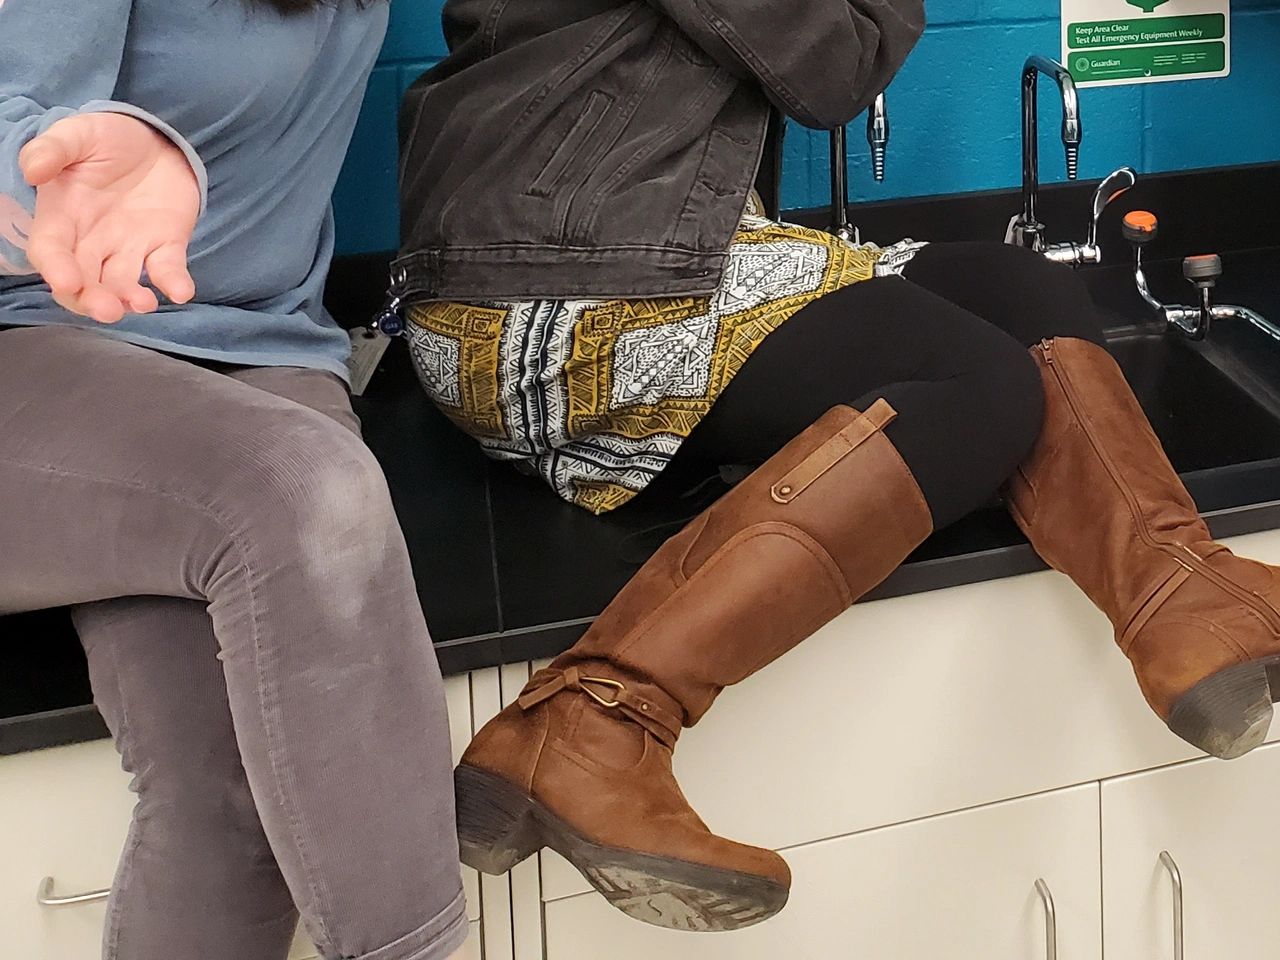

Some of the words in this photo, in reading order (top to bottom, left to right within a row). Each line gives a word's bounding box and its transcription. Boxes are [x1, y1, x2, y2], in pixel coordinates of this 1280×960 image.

[1075, 27, 1094, 36] Keep
[1111, 24, 1129, 32] Clear
[1075, 36, 1090, 44] Test
[1091, 35, 1101, 43] All
[1101, 34, 1140, 43] Emergency
[1140, 31, 1178, 41] Equipment
[1178, 28, 1203, 37] Weekly
[1091, 59, 1121, 68] Guardian
